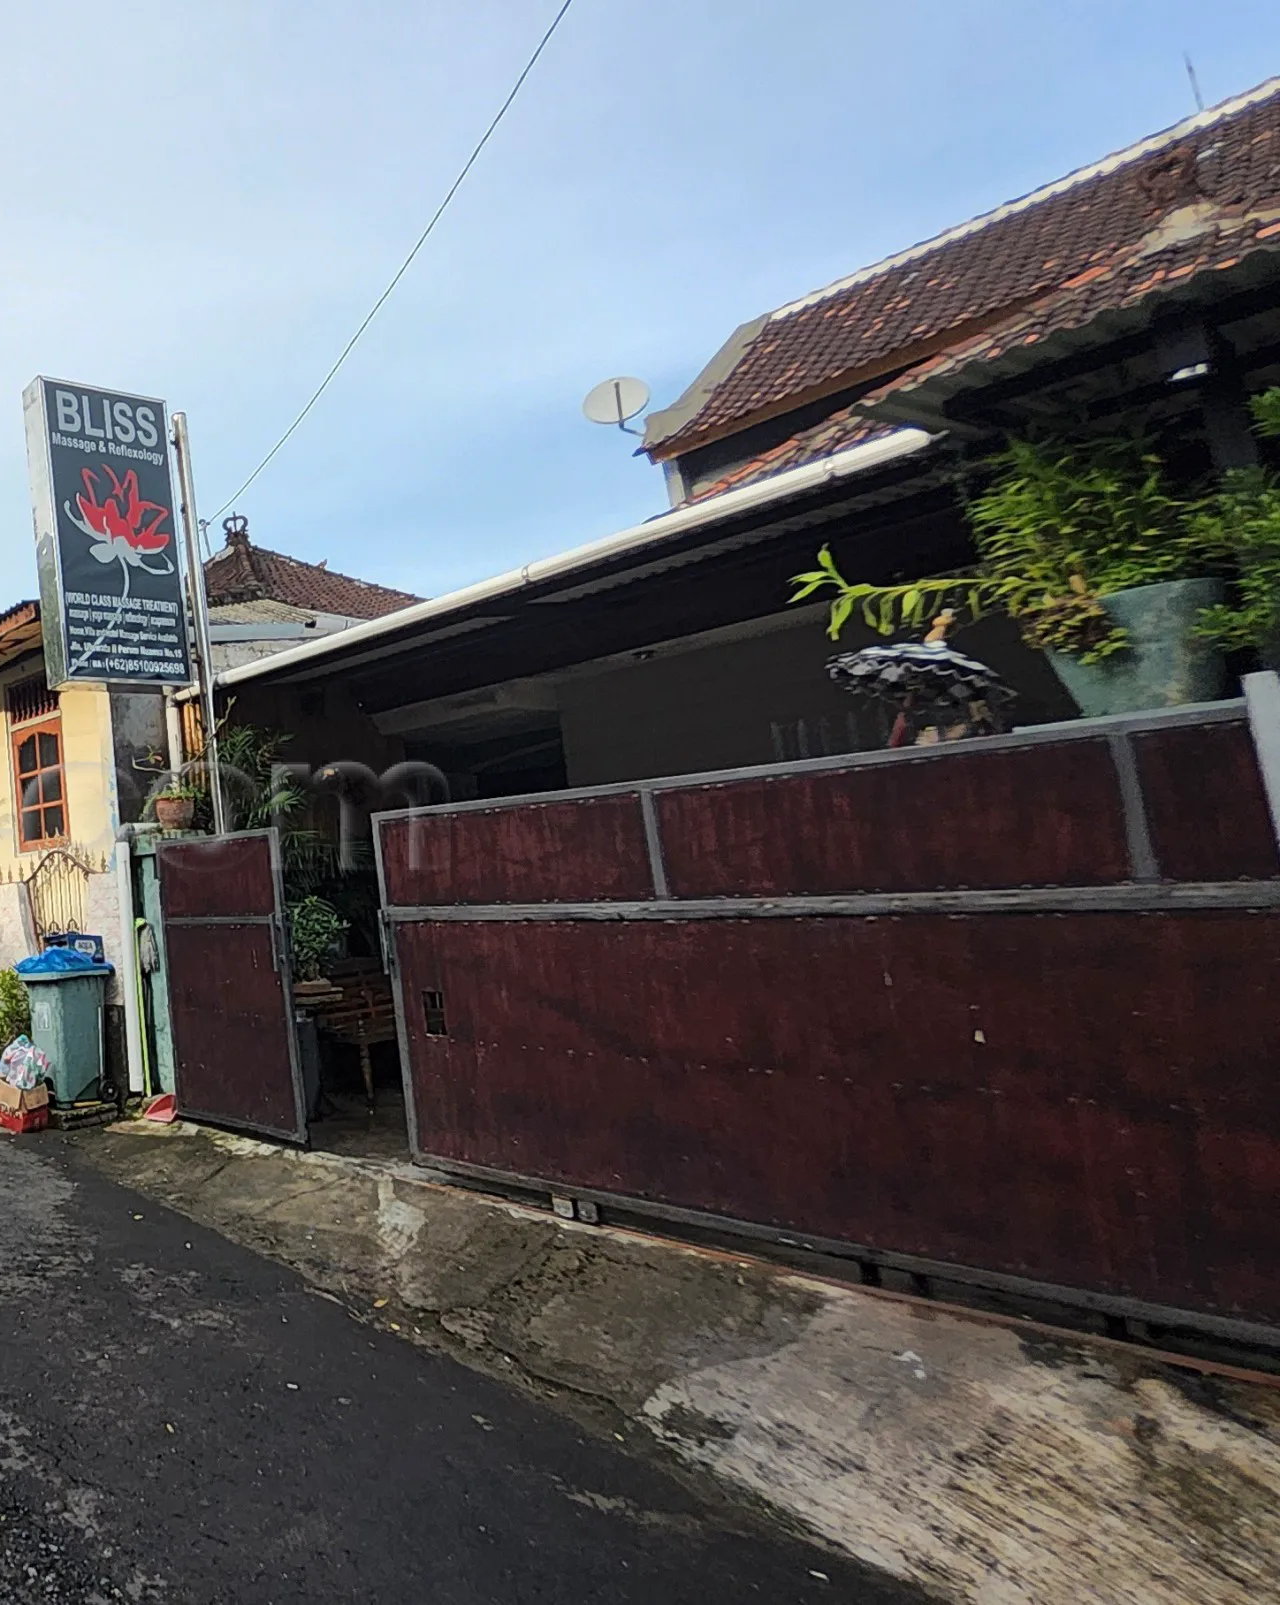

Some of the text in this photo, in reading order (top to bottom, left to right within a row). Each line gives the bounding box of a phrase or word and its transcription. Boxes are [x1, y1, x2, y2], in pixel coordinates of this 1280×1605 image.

[55, 389, 158, 448] BLISS
[52, 431, 165, 466] Massage & Reflexology
[65, 591, 179, 616] (WORLD CLASS MASSAGE TREATMENT)
